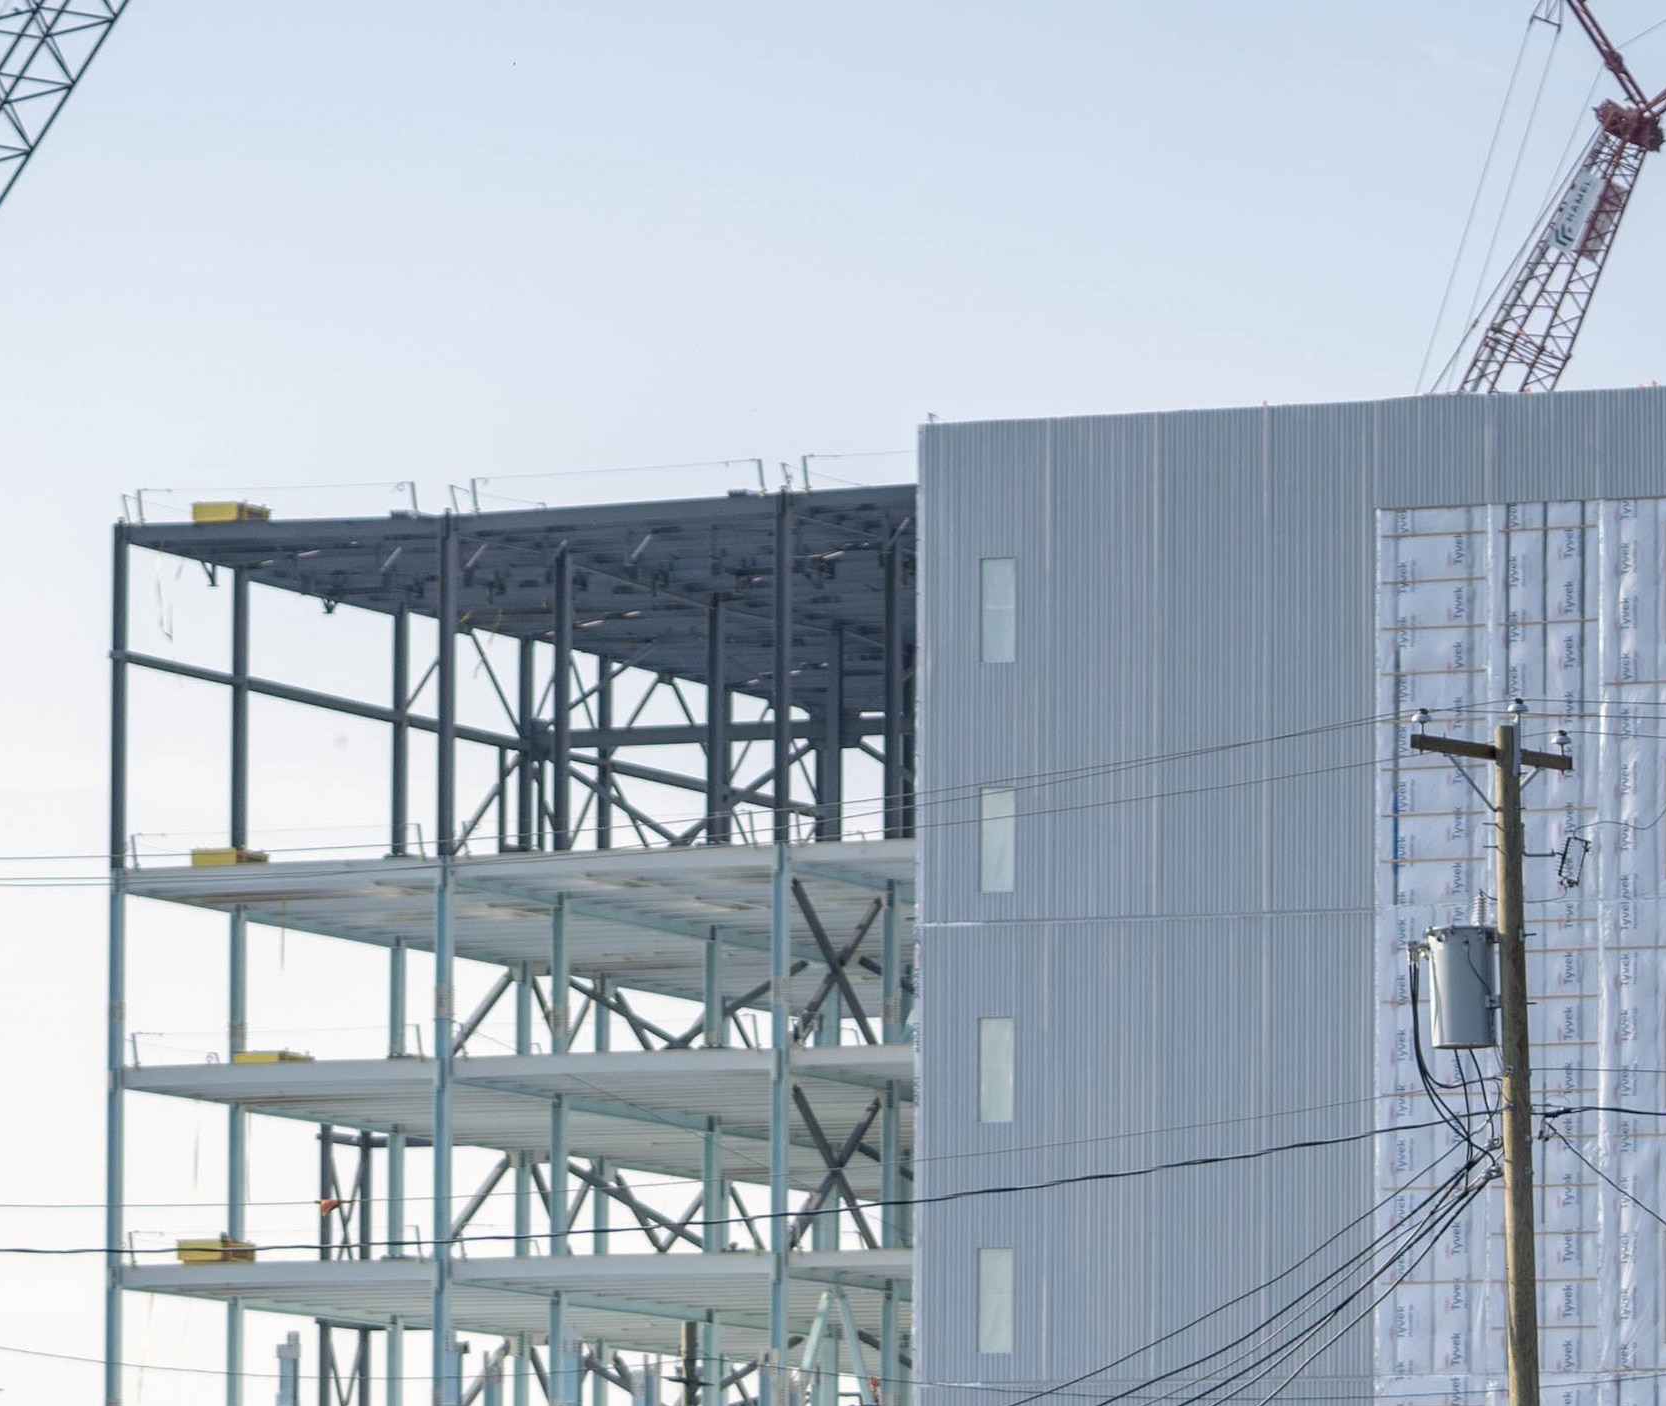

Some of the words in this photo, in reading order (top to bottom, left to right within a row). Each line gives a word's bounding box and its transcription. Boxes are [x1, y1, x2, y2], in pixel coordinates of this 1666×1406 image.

[1509, 556, 1519, 588] Tyvek
[1620, 543, 1630, 575] Tyvek
[1453, 587, 1463, 619] Tyvek
[1563, 581, 1574, 614] Tyvek
[1620, 598, 1630, 630] Tyvek
[1398, 616, 1408, 648] Tyvek
[1453, 642, 1463, 671] yvek
[1563, 636, 1574, 668] Tyvek
[1509, 666, 1519, 697] Tyvek
[1620, 708, 1630, 741] Tyvek
[1620, 764, 1630, 796] Tyvek
[1452, 862, 1463, 894] Tyvek
[1397, 919, 1408, 951] Tyvek
[1564, 952, 1575, 985] Tyvek
[1620, 954, 1630, 987] Tyvek
[1564, 1006, 1575, 1039] Tyvek
[1620, 1010, 1630, 1042] Tyvek
[1396, 1029, 1407, 1061] Tyvek
[1619, 1065, 1629, 1097] Tyvek
[1396, 1140, 1407, 1172] Tyvek
[1563, 1174, 1574, 1206] Tyvek
[1451, 1222, 1462, 1255] Tyvek
[1562, 1285, 1572, 1318] Tyvek
[1394, 1306, 1405, 1337] Tyvek
[1450, 1333, 1461, 1365] Tyvek
